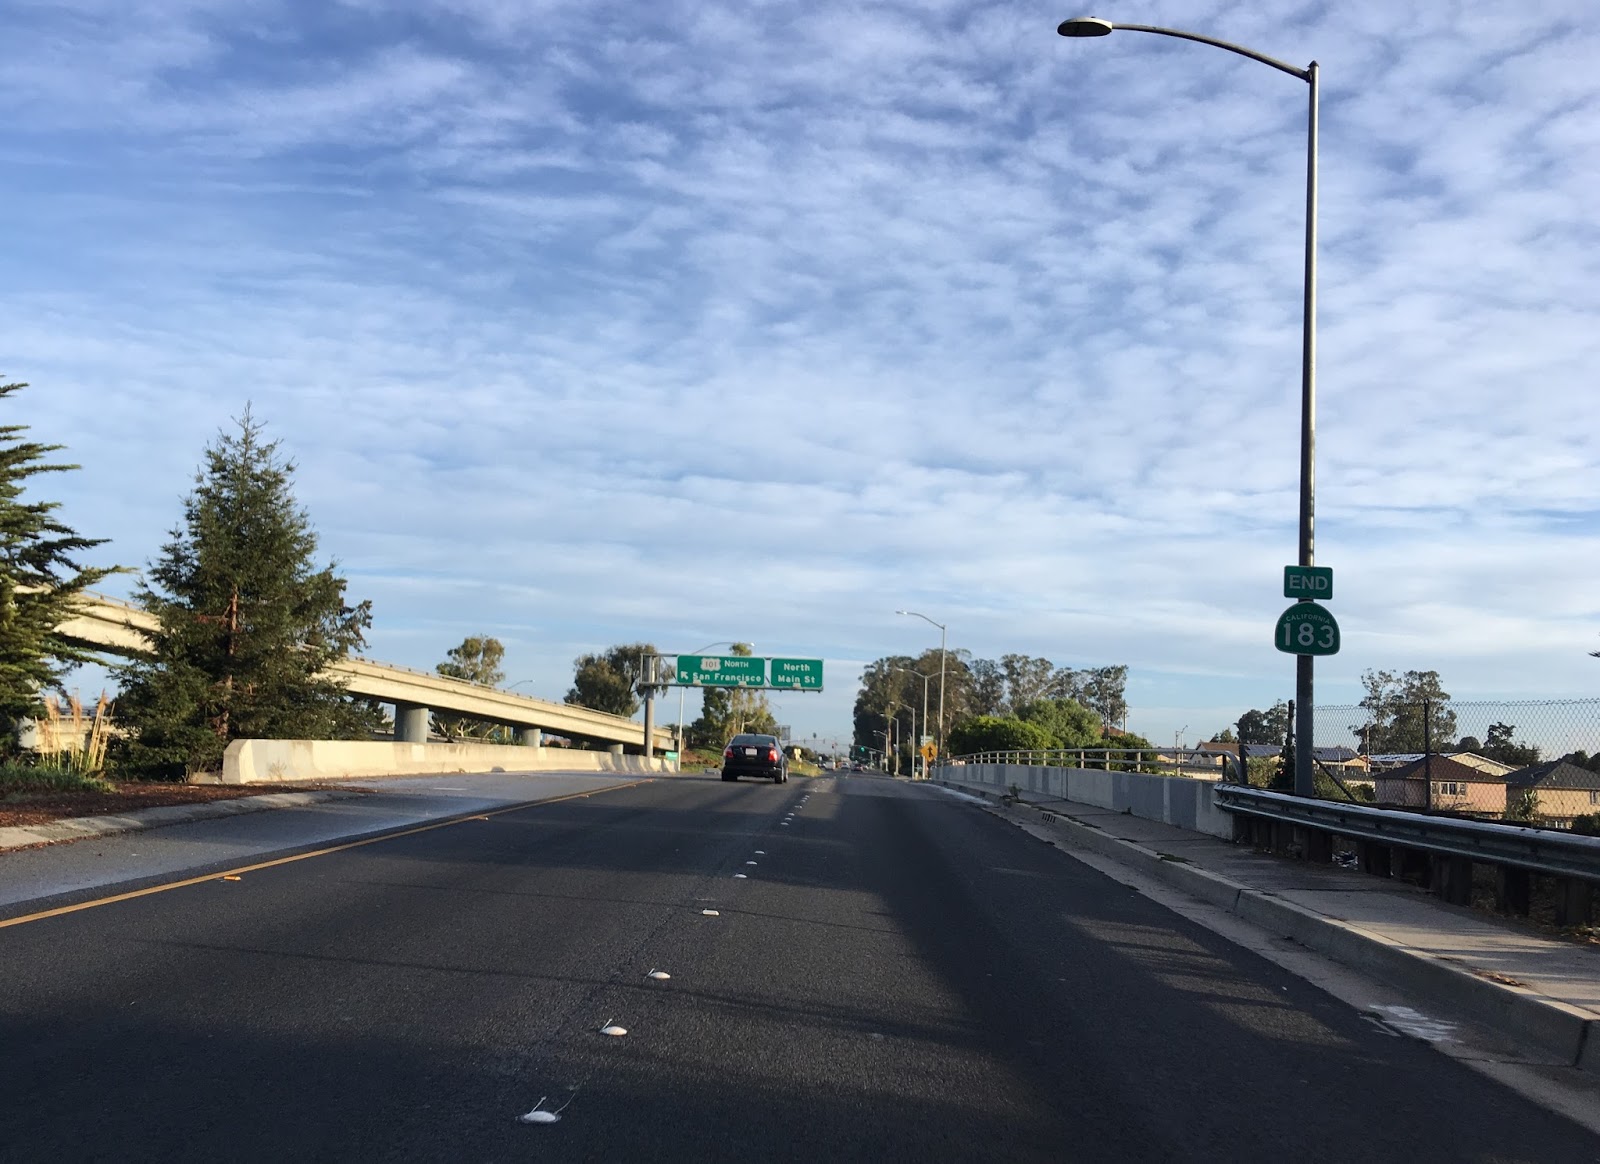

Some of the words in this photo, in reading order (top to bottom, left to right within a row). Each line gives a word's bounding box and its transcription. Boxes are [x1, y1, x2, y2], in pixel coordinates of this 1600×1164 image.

[1289, 574, 1329, 590] END
[1286, 613, 1331, 625] CALIFORNIA
[1283, 622, 1335, 648] 183
[724, 660, 749, 668] NORTH
[783, 663, 811, 672] North
[692, 672, 711, 681] San
[714, 672, 762, 683] Francisco
[777, 675, 801, 683] Main
[804, 675, 816, 684] St
